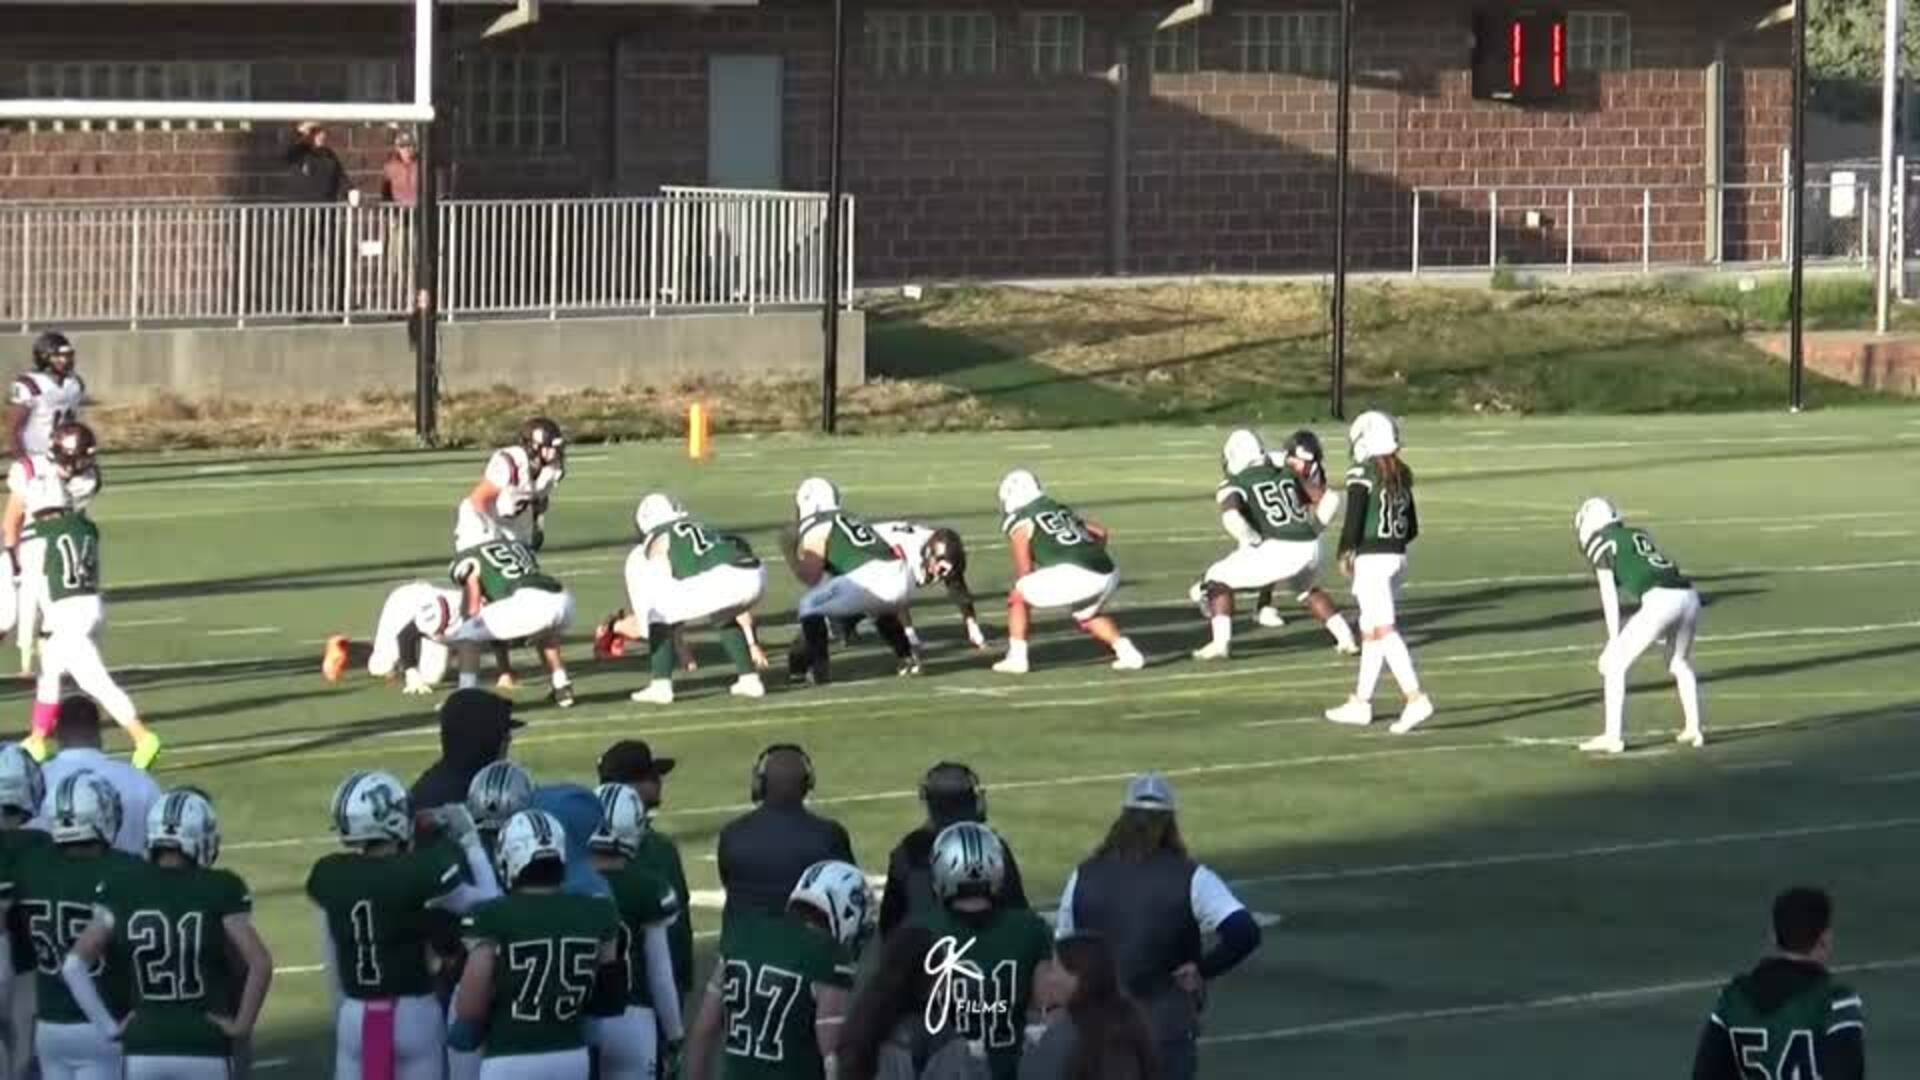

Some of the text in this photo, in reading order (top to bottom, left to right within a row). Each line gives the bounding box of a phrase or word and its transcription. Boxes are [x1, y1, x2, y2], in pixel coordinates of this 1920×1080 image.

[127, 909, 204, 1000] 21
[350, 900, 381, 985] 1
[509, 938, 600, 1021] 75
[722, 958, 803, 1061] 27
